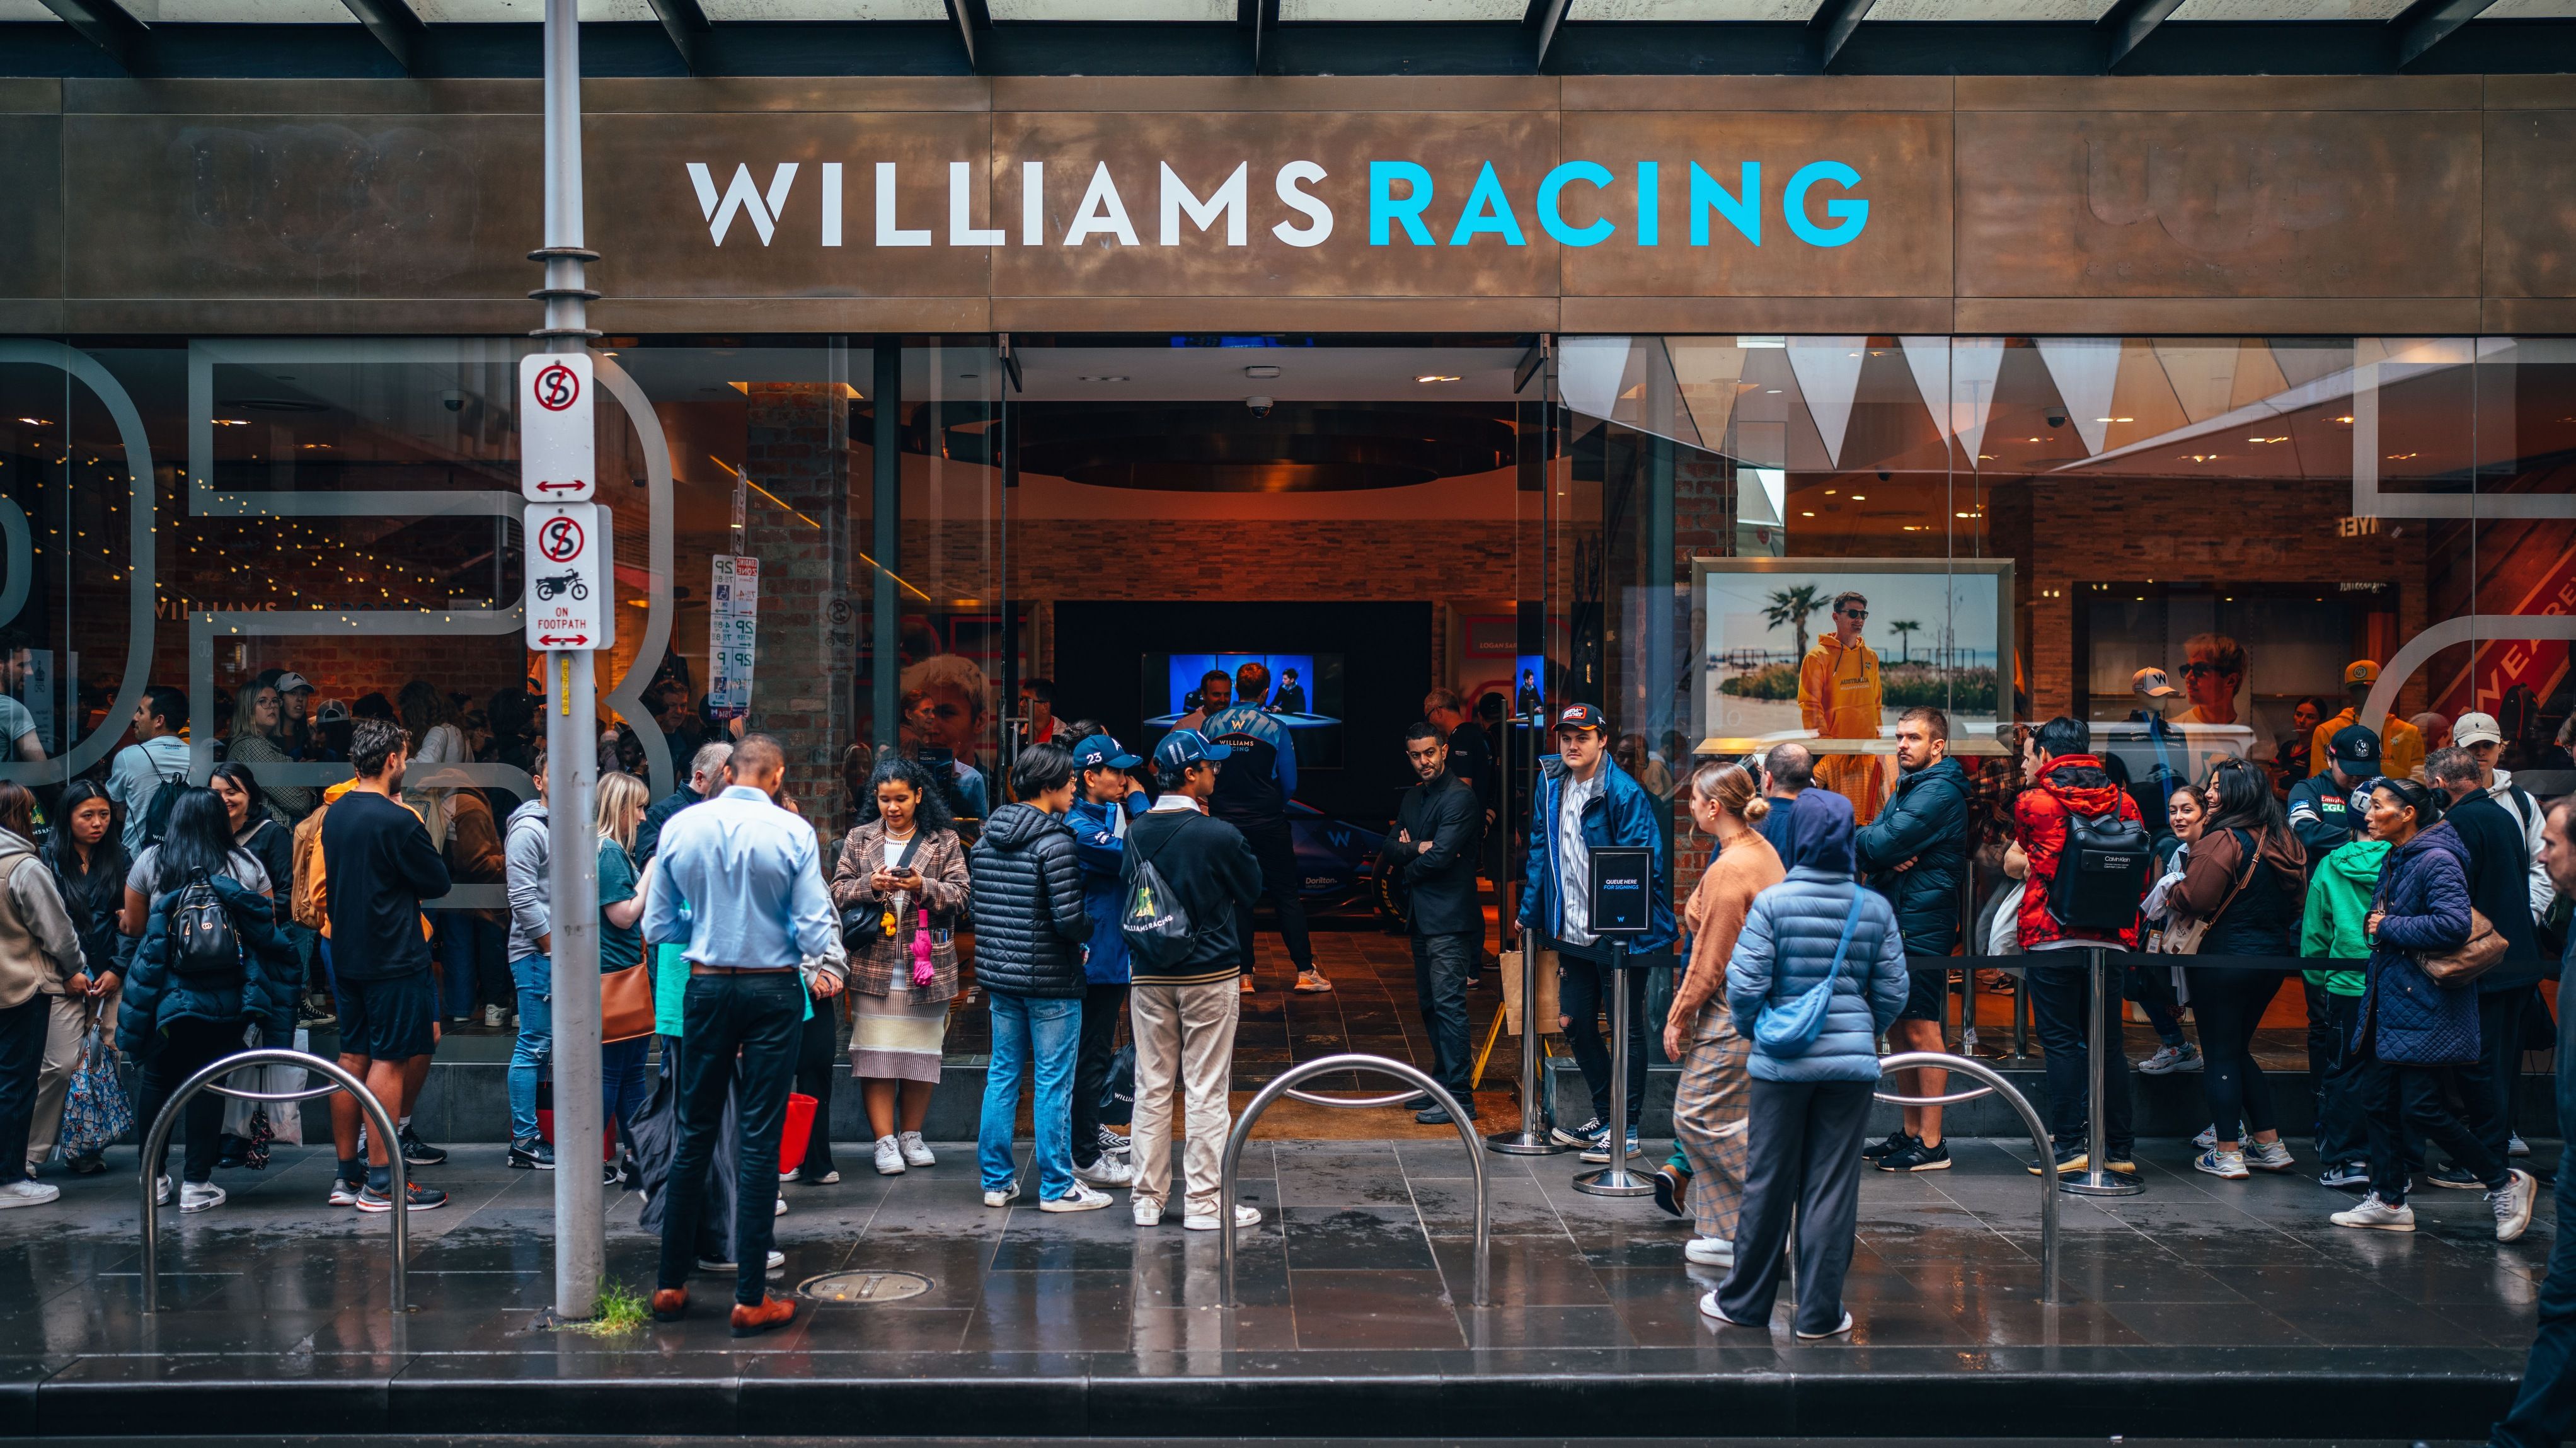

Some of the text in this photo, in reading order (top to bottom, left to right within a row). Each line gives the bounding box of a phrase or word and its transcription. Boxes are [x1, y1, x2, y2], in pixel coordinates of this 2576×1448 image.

[686, 160, 1870, 248] WILLIAMS RACING
[556, 607, 568, 617] ON
[538, 620, 586, 629] FOOTPATH
[1086, 752, 1102, 766] 23
[2322, 803, 2344, 812] CGU
[1123, 915, 1173, 932] WILLIAMS RACING
[1115, 1092, 1135, 1103] WILLIA
